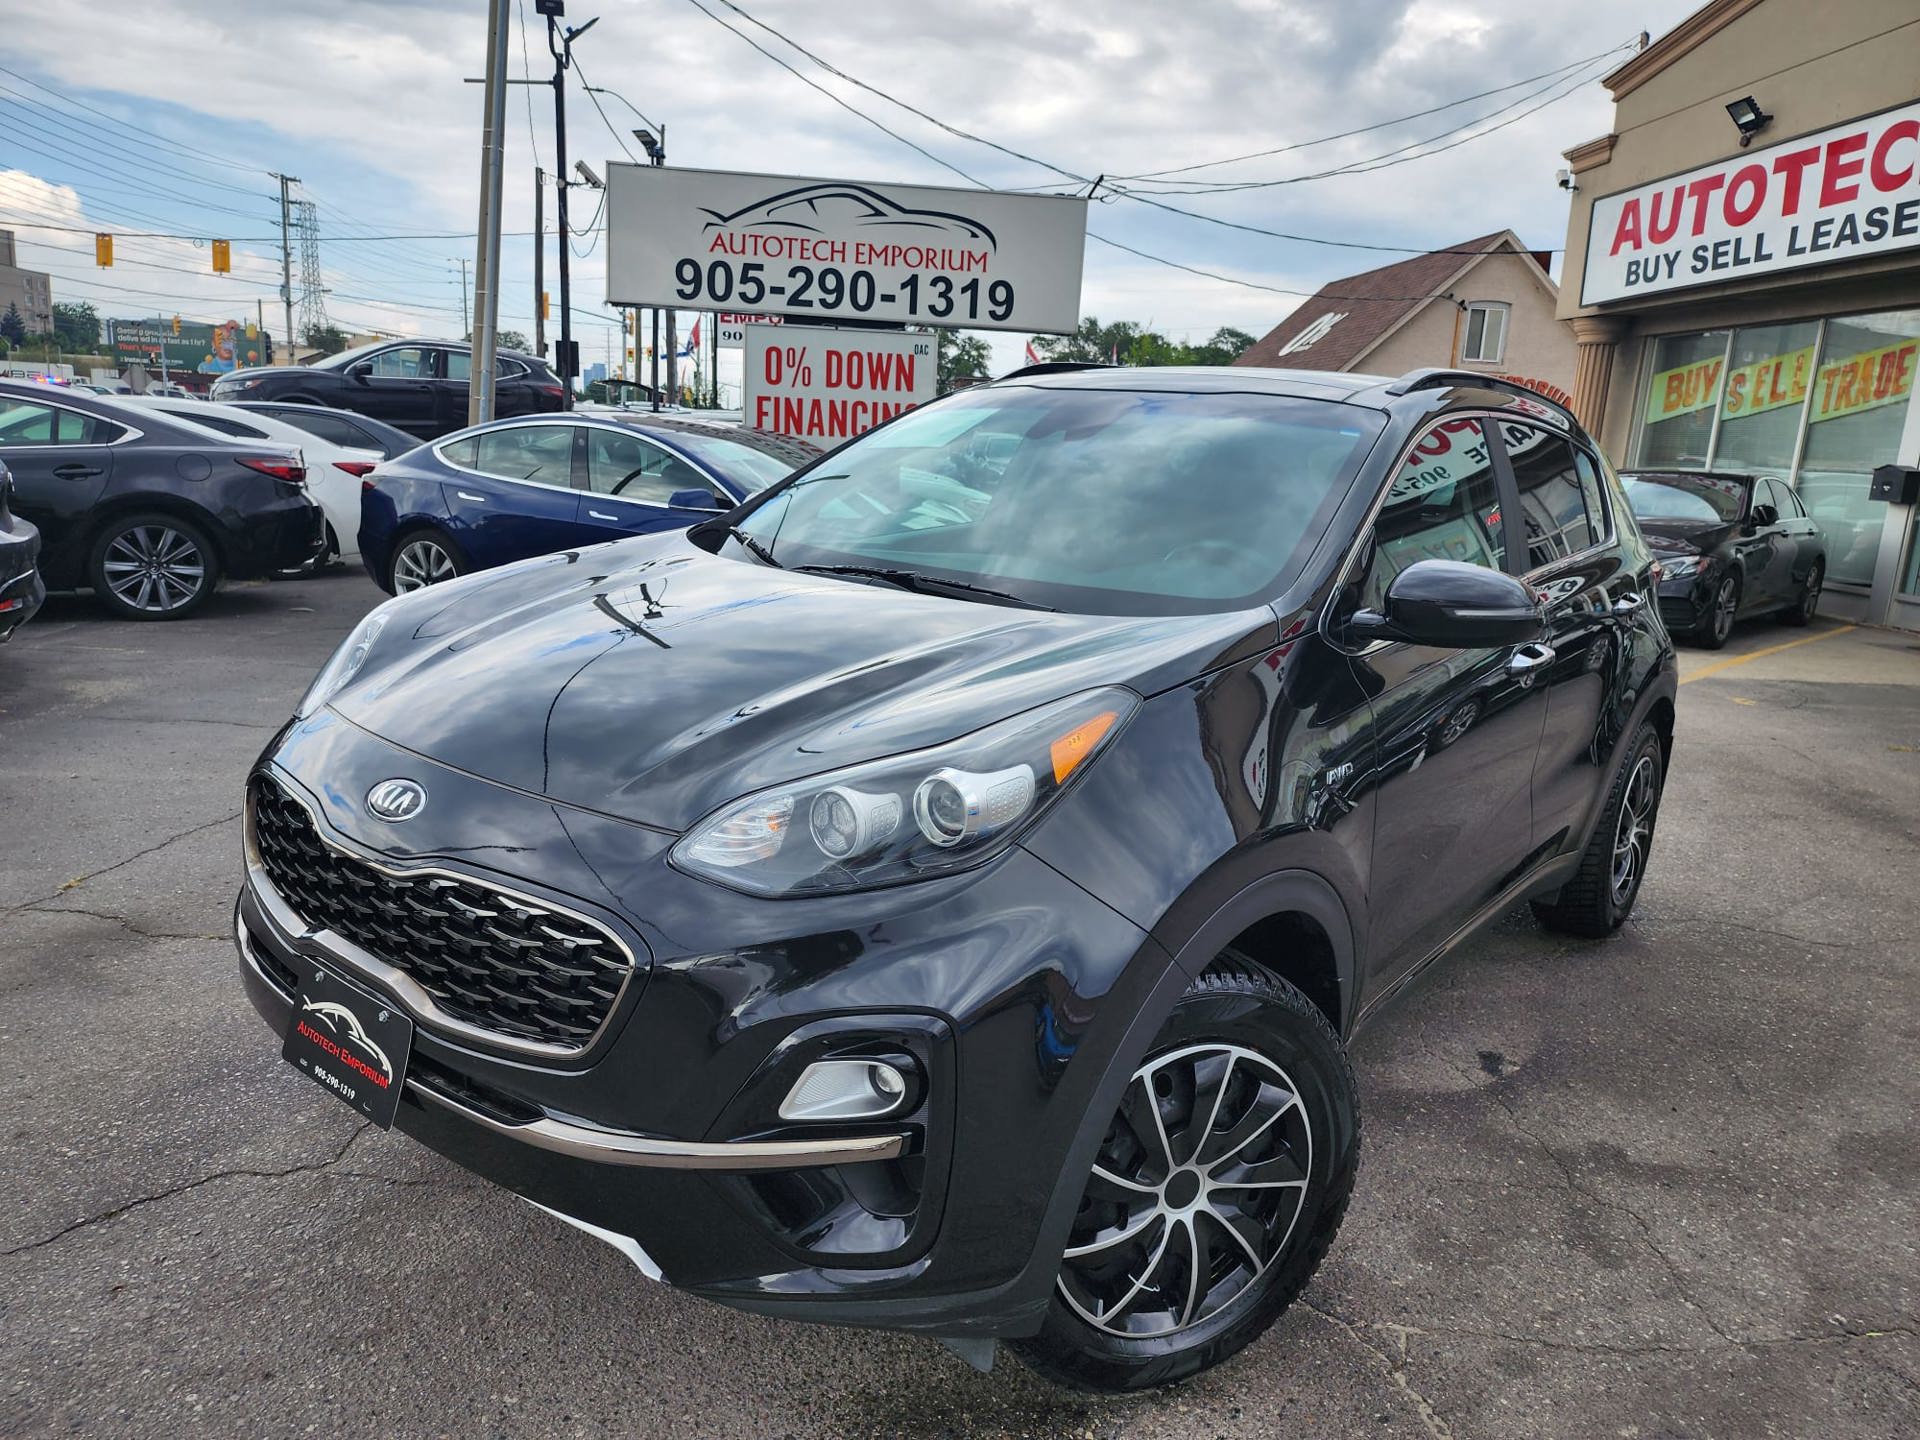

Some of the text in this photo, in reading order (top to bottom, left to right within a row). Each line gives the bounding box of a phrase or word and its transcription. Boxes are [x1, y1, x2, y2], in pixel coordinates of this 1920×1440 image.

[1610, 120, 1920, 257] AUTOTEC
[709, 232, 989, 273] AUTOTECH EMPORIUM
[1624, 199, 1920, 286] BUY SELL LEASE
[675, 257, 1015, 321] 905-290-1319
[765, 346, 915, 392] 0% DOWN
[914, 344, 929, 356] OAC
[1663, 345, 1916, 414] BUY SELL TRADE
[756, 396, 917, 437] FINANCIN
[370, 782, 416, 814] KIA
[297, 1020, 390, 1090] AUTOTECH EMPORIUM
[314, 1065, 356, 1100] 905-290-1319
